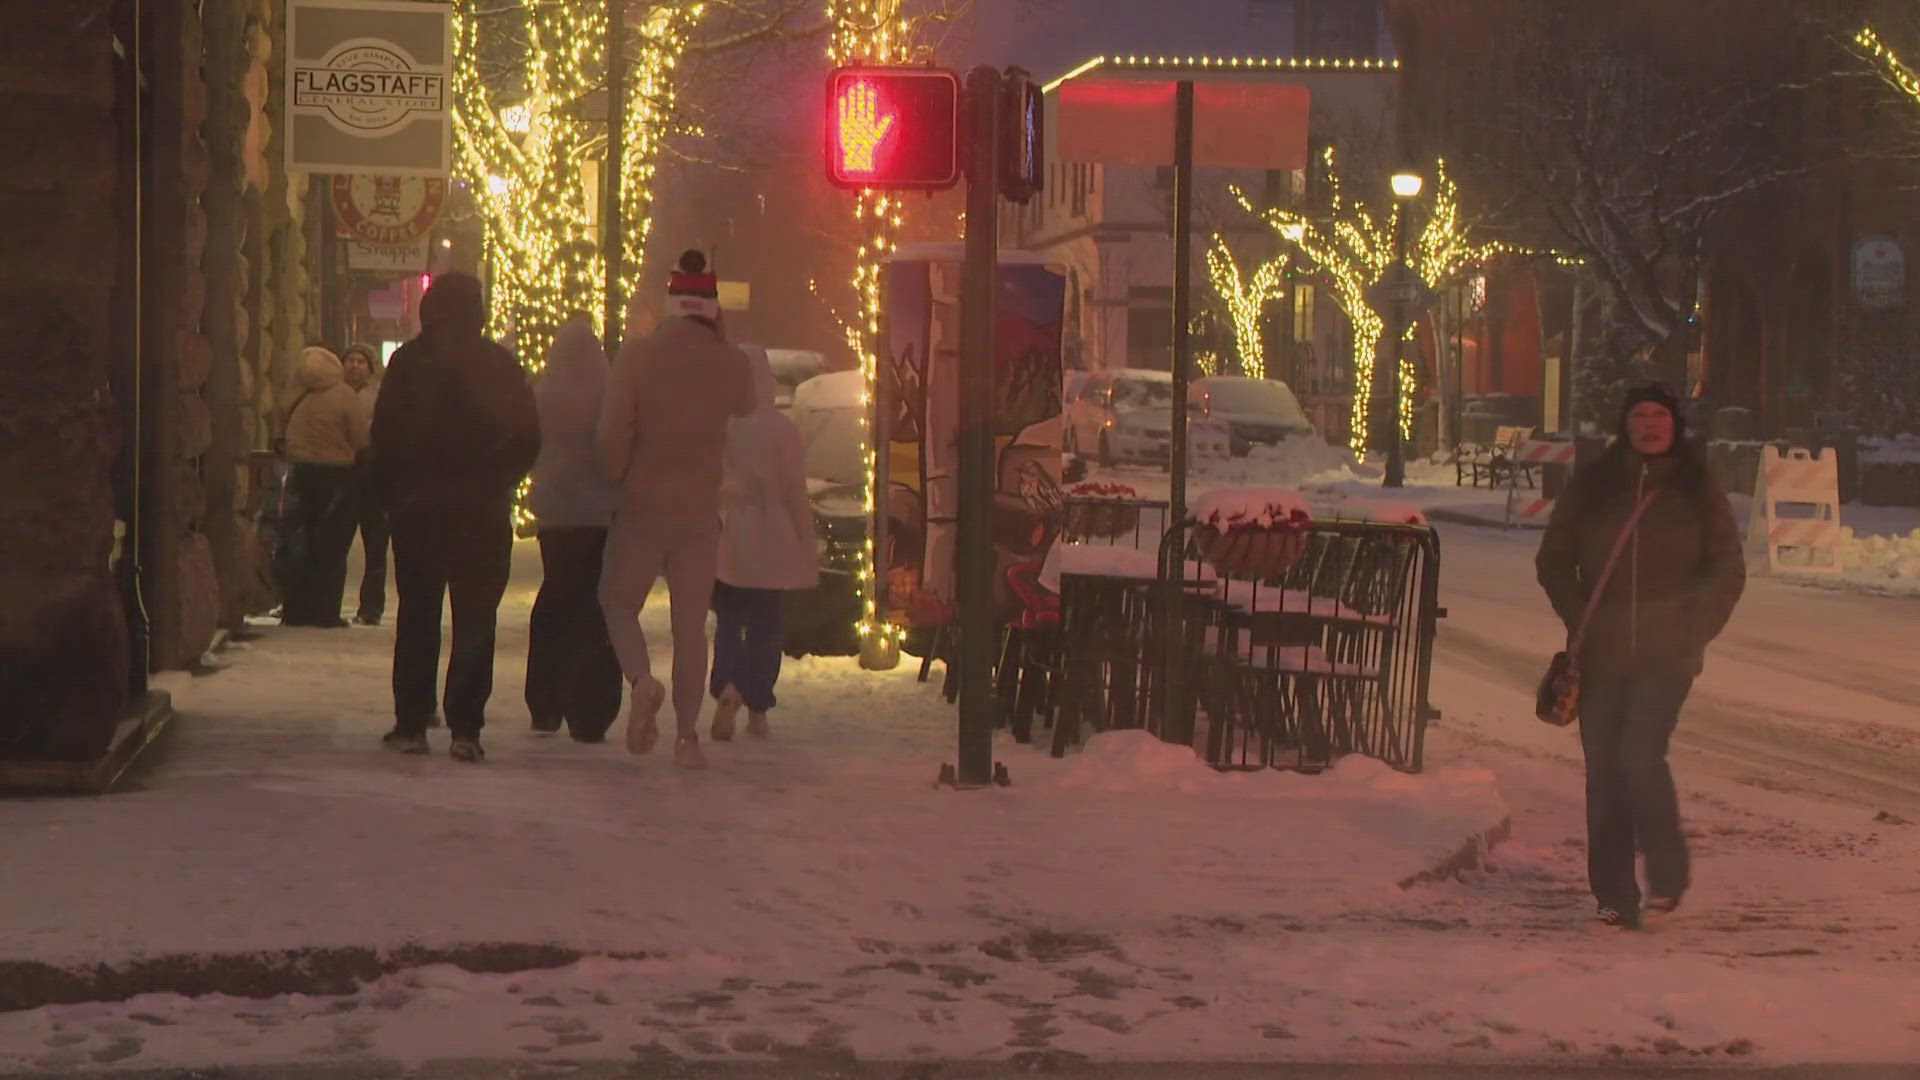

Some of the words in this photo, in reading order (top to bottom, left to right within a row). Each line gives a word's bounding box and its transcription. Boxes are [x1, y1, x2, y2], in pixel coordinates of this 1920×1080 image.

[336, 53, 358, 68] LIVE
[363, 52, 401, 69] SIMPLE
[295, 71, 438, 95] FLAGSTAFF
[299, 95, 374, 106] GENERAL
[386, 98, 436, 107] STORE
[356, 221, 417, 242] COFFEE
